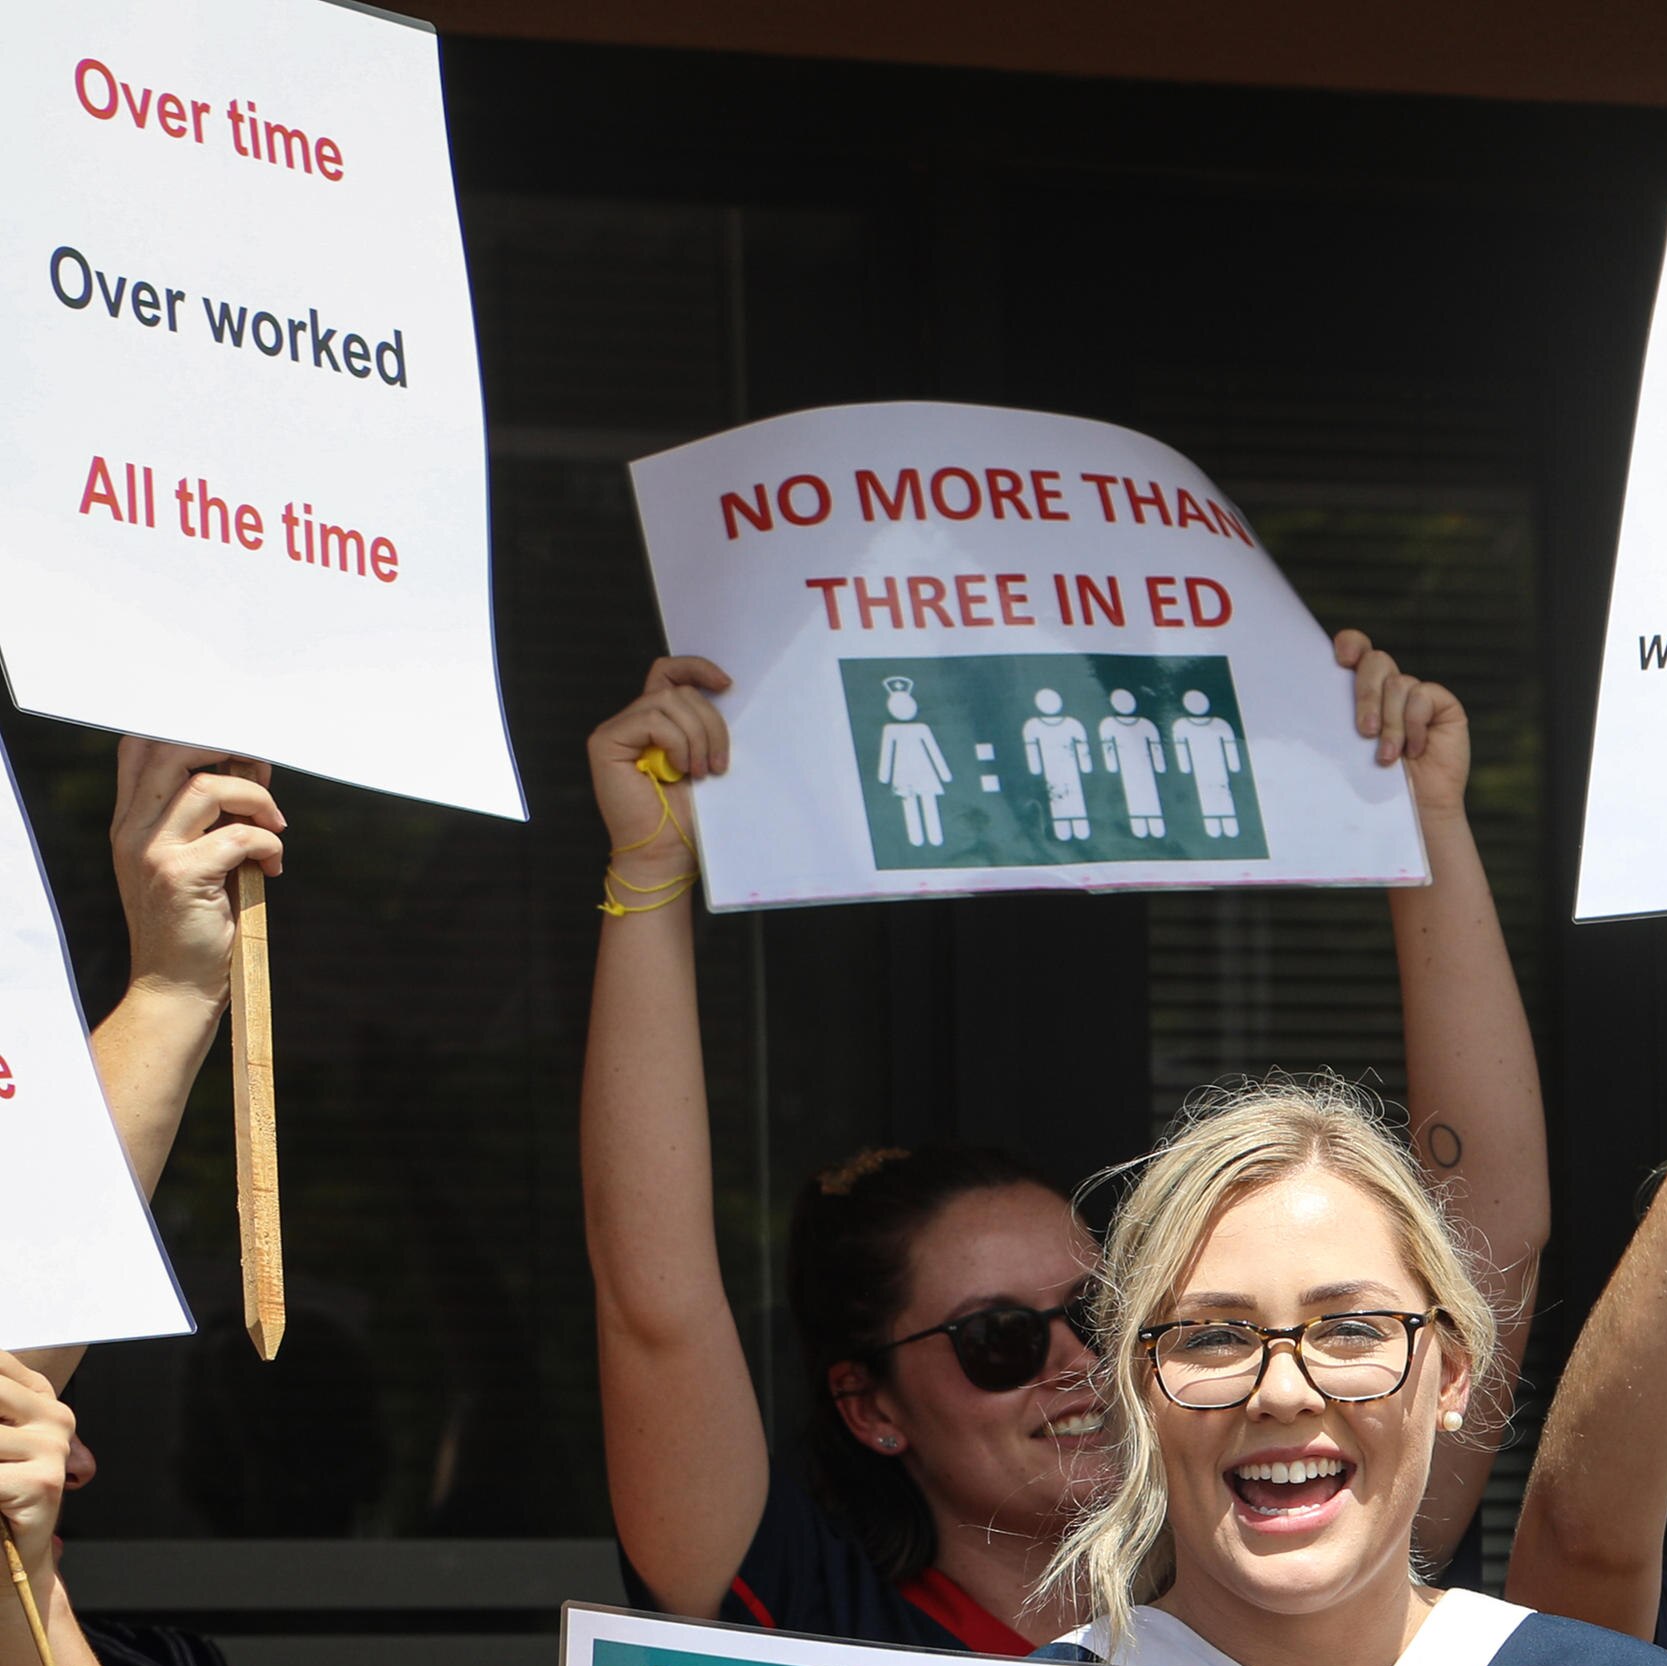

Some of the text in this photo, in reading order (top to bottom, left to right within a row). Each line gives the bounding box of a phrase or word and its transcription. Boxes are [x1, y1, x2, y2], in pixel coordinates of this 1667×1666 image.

[74, 58, 344, 182] Over time
[49, 246, 408, 389] Over worked
[79, 455, 400, 584] All the time
[719, 466, 1257, 549] NO MORE THAN
[805, 573, 1234, 631] THREE IN ED
